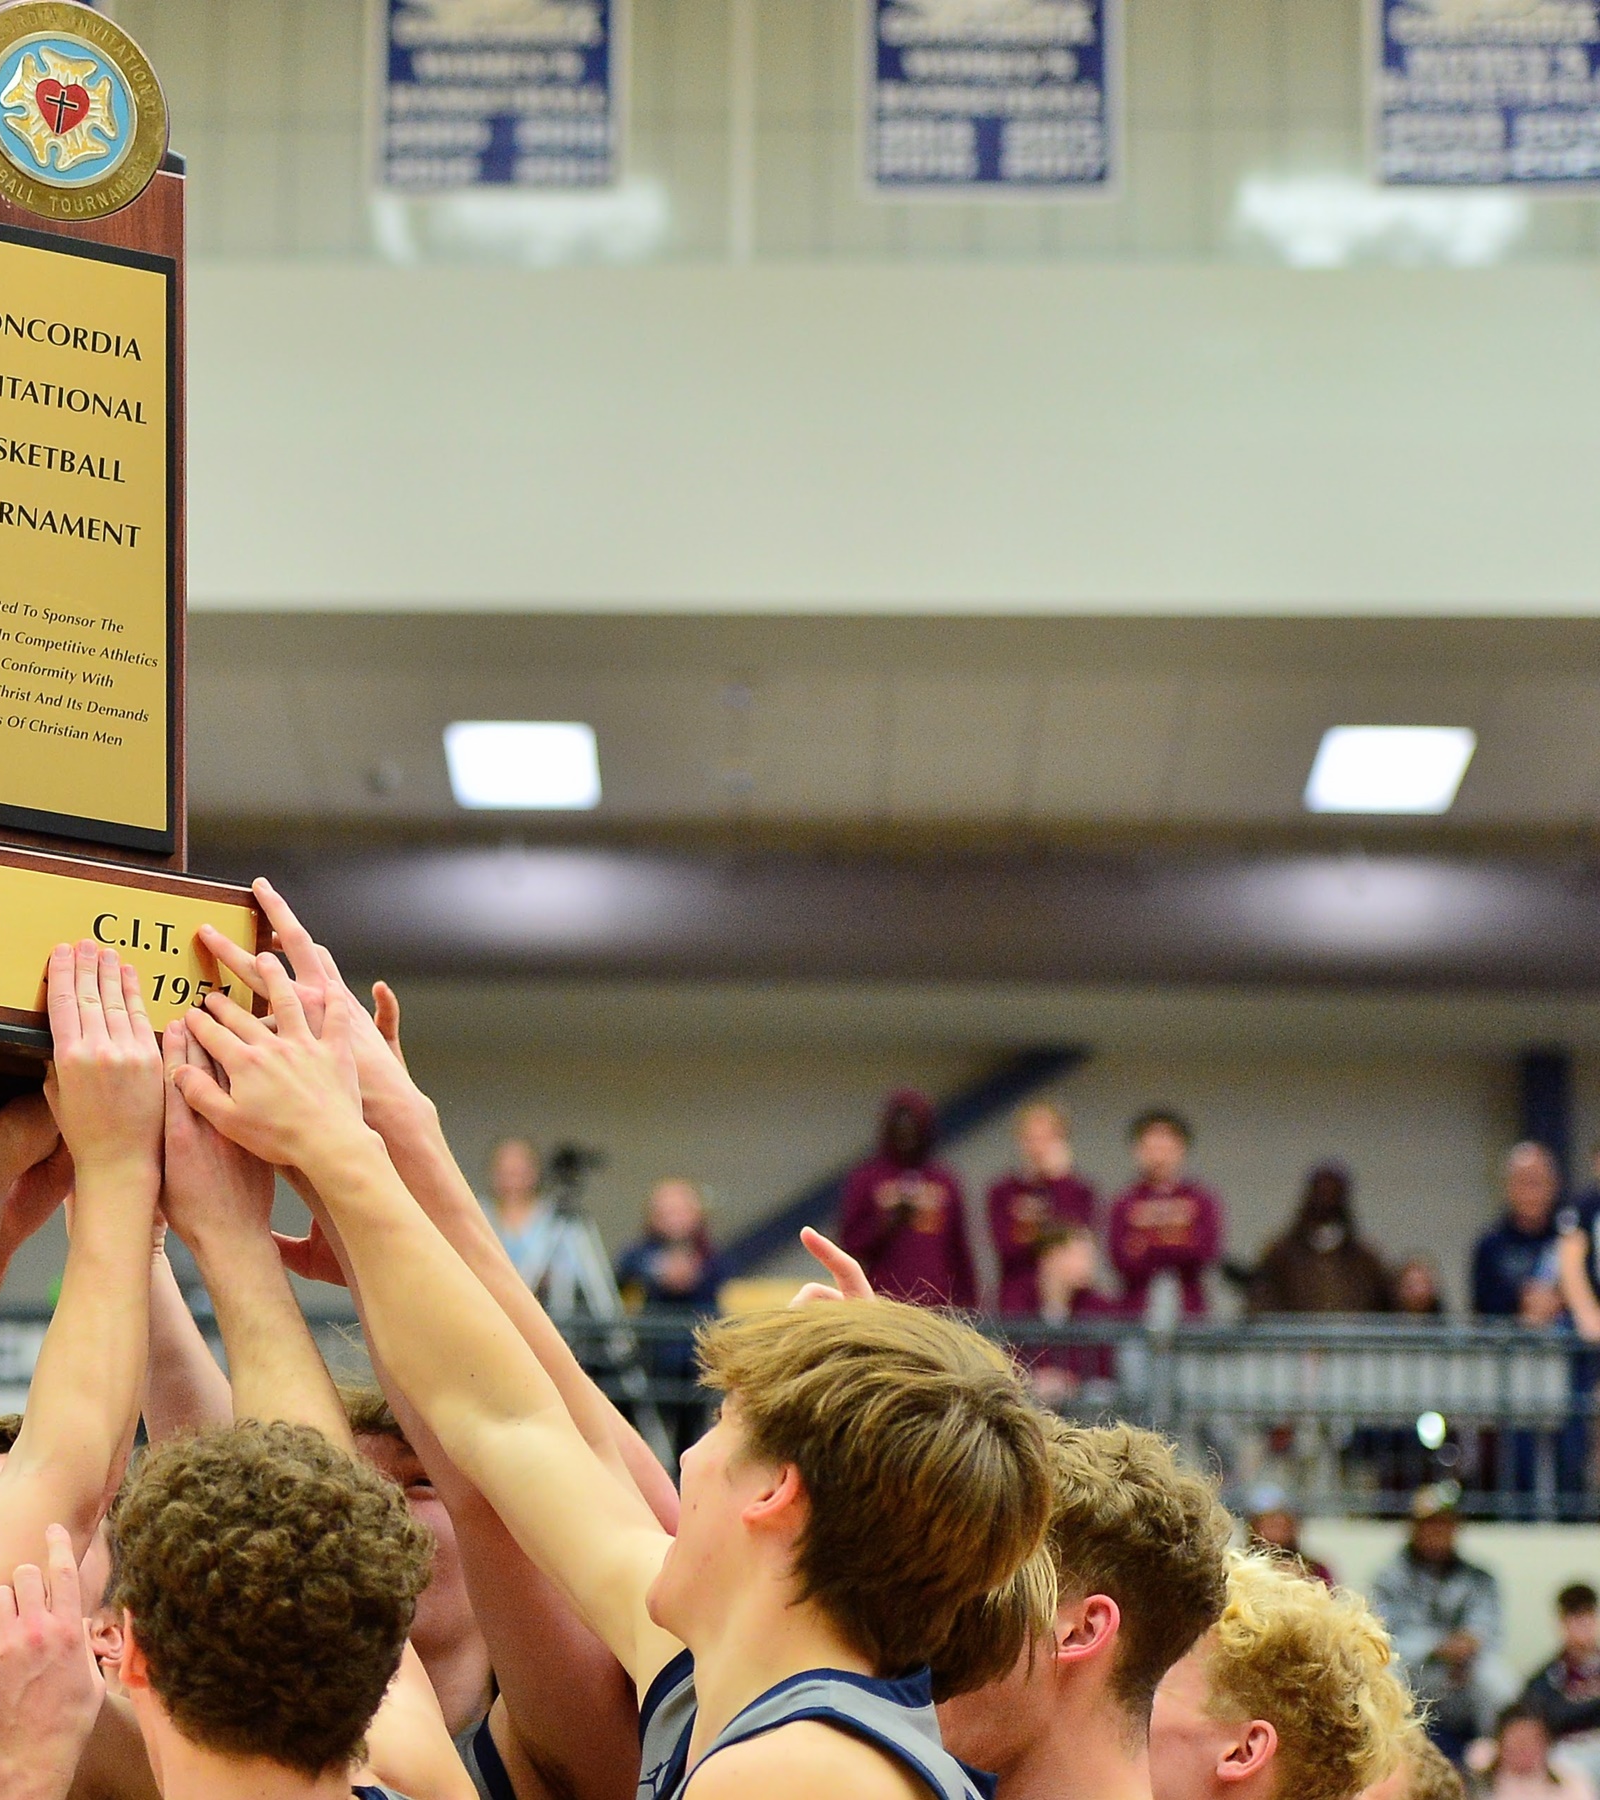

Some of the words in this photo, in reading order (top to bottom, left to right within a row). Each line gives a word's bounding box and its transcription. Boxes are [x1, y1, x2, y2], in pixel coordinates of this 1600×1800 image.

[50, 151, 150, 214] TOURNAMENT
[22, 604, 38, 618] To
[42, 608, 96, 628] Sponsor
[100, 618, 124, 633] The
[14, 632, 96, 656] Competitive
[100, 647, 158, 668] Athletics
[1, 658, 77, 684] Conformity
[82, 672, 114, 688] With
[34, 692, 62, 707] And
[67, 698, 82, 711] Its
[86, 701, 150, 722] Demands
[7, 716, 27, 728] Of
[29, 719, 88, 740] Christian
[92, 731, 122, 746] Men
[93, 914, 179, 955] C.I.T.
